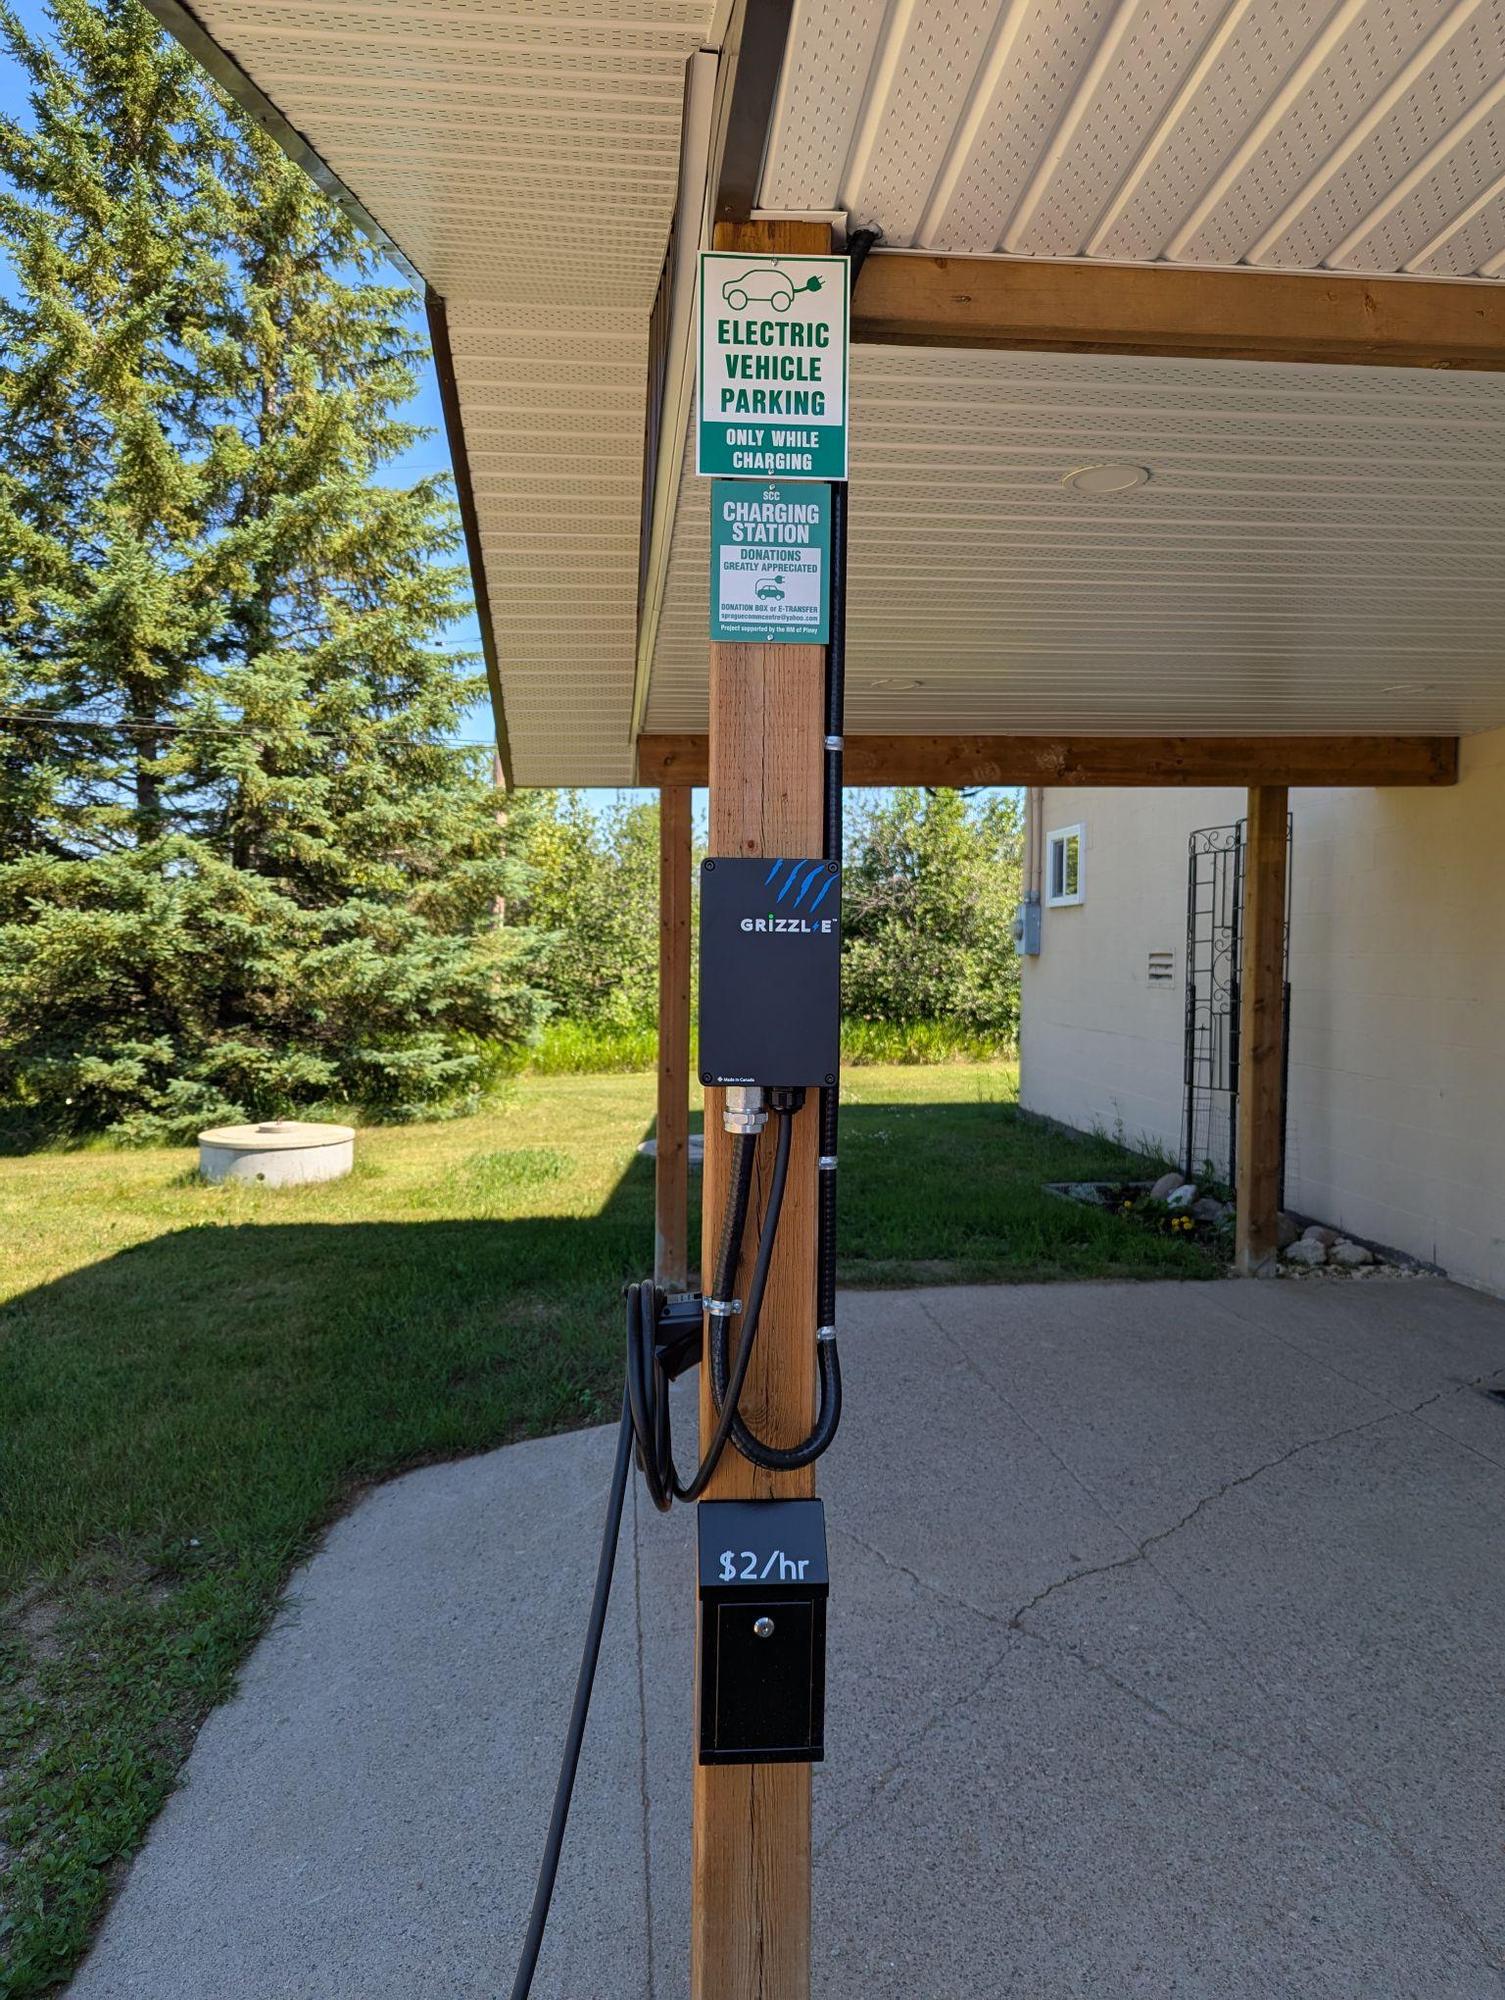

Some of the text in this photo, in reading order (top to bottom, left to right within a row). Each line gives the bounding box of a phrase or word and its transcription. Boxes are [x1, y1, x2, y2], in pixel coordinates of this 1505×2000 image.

[718, 319, 829, 348] ELECTRIC
[725, 354, 822, 382] VEHICLE
[721, 388, 825, 416] PARKING
[726, 428, 819, 448] ONLY WHILE
[733, 451, 812, 470] CHARGING
[762, 491, 780, 501] SCC
[723, 501, 819, 524] CHARGING
[732, 522, 810, 544] STATION
[740, 549, 801, 561] DONATIONS
[723, 562, 817, 573] GREATLY APPRECIATED
[721, 603, 753, 611] DONATION
[755, 604, 768, 612] BOX
[778, 605, 818, 613] E-TRANSFER
[720, 624, 740, 632] Project
[719, 1550, 810, 1582] $2/hr
